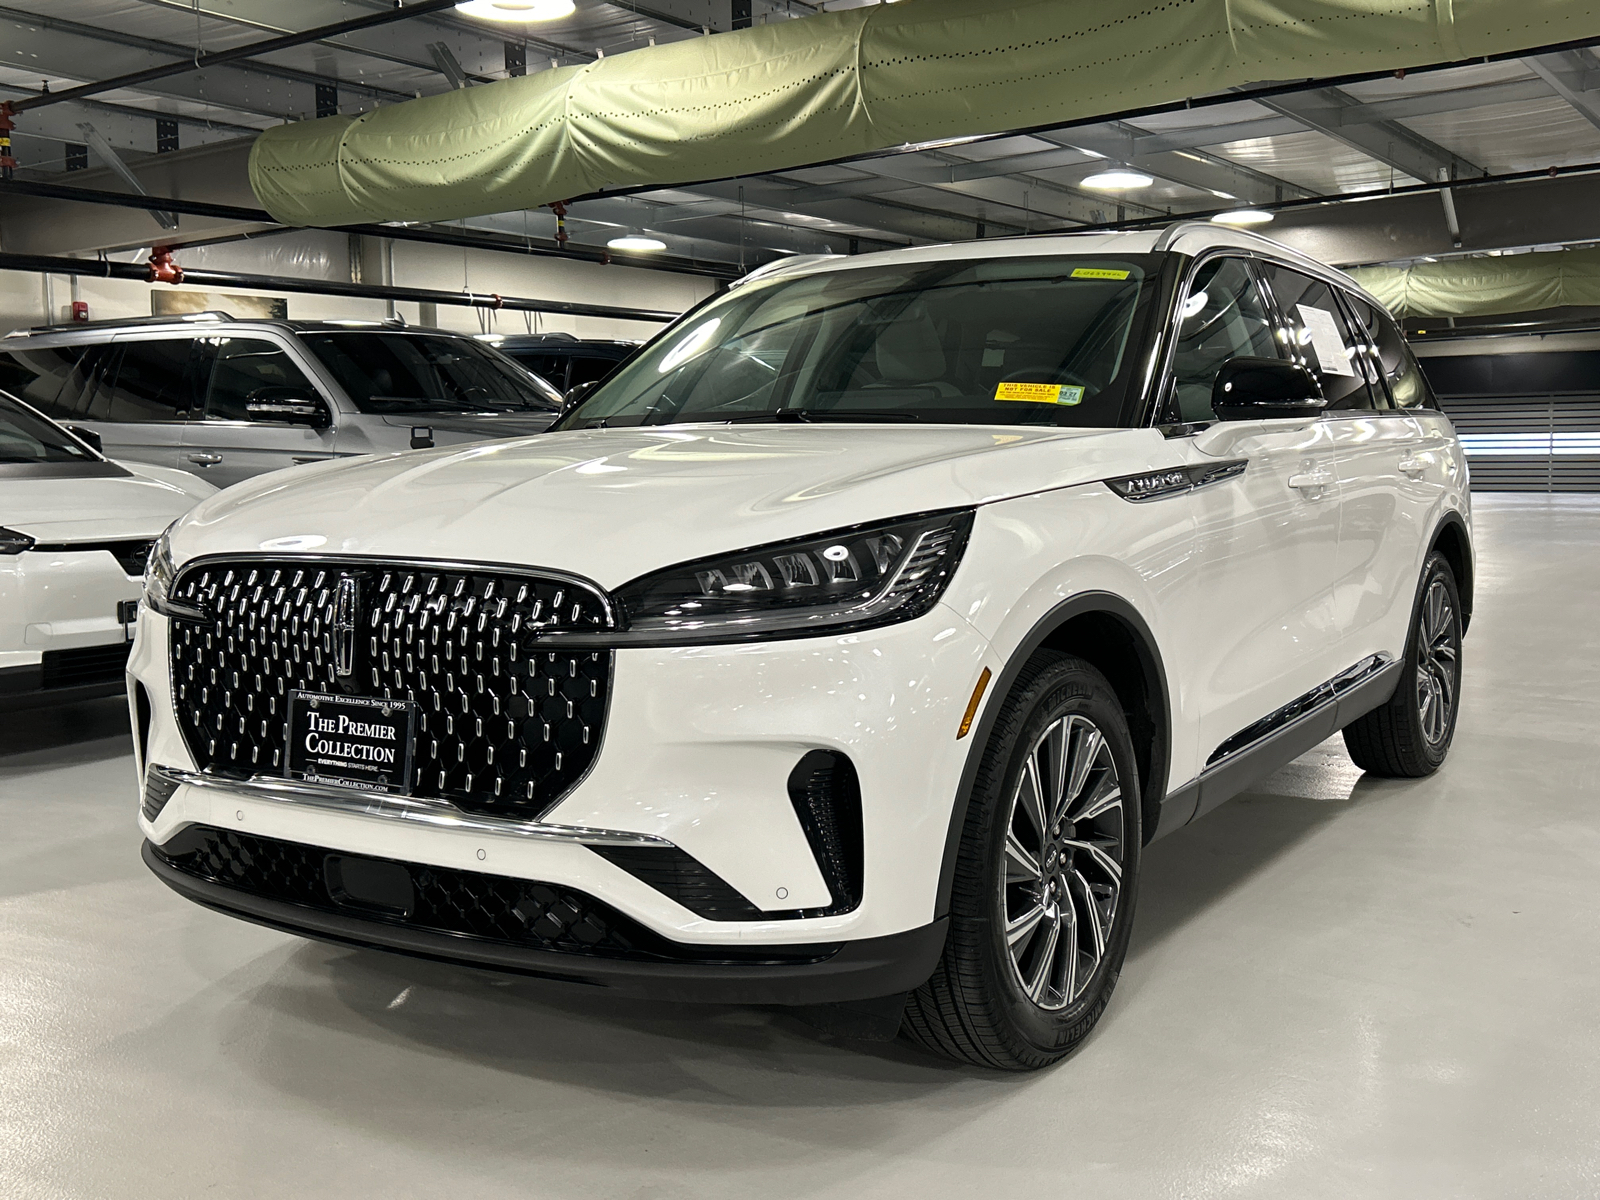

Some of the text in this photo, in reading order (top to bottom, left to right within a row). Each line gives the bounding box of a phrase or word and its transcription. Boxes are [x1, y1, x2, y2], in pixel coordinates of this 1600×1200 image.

[389, 701, 406, 710] 1995
[1048, 682, 1093, 713] MICHELIN
[317, 758, 348, 768] EVERYTHING
[348, 762, 365, 770] STARTS
[1056, 998, 1102, 1045] MICHELIN
